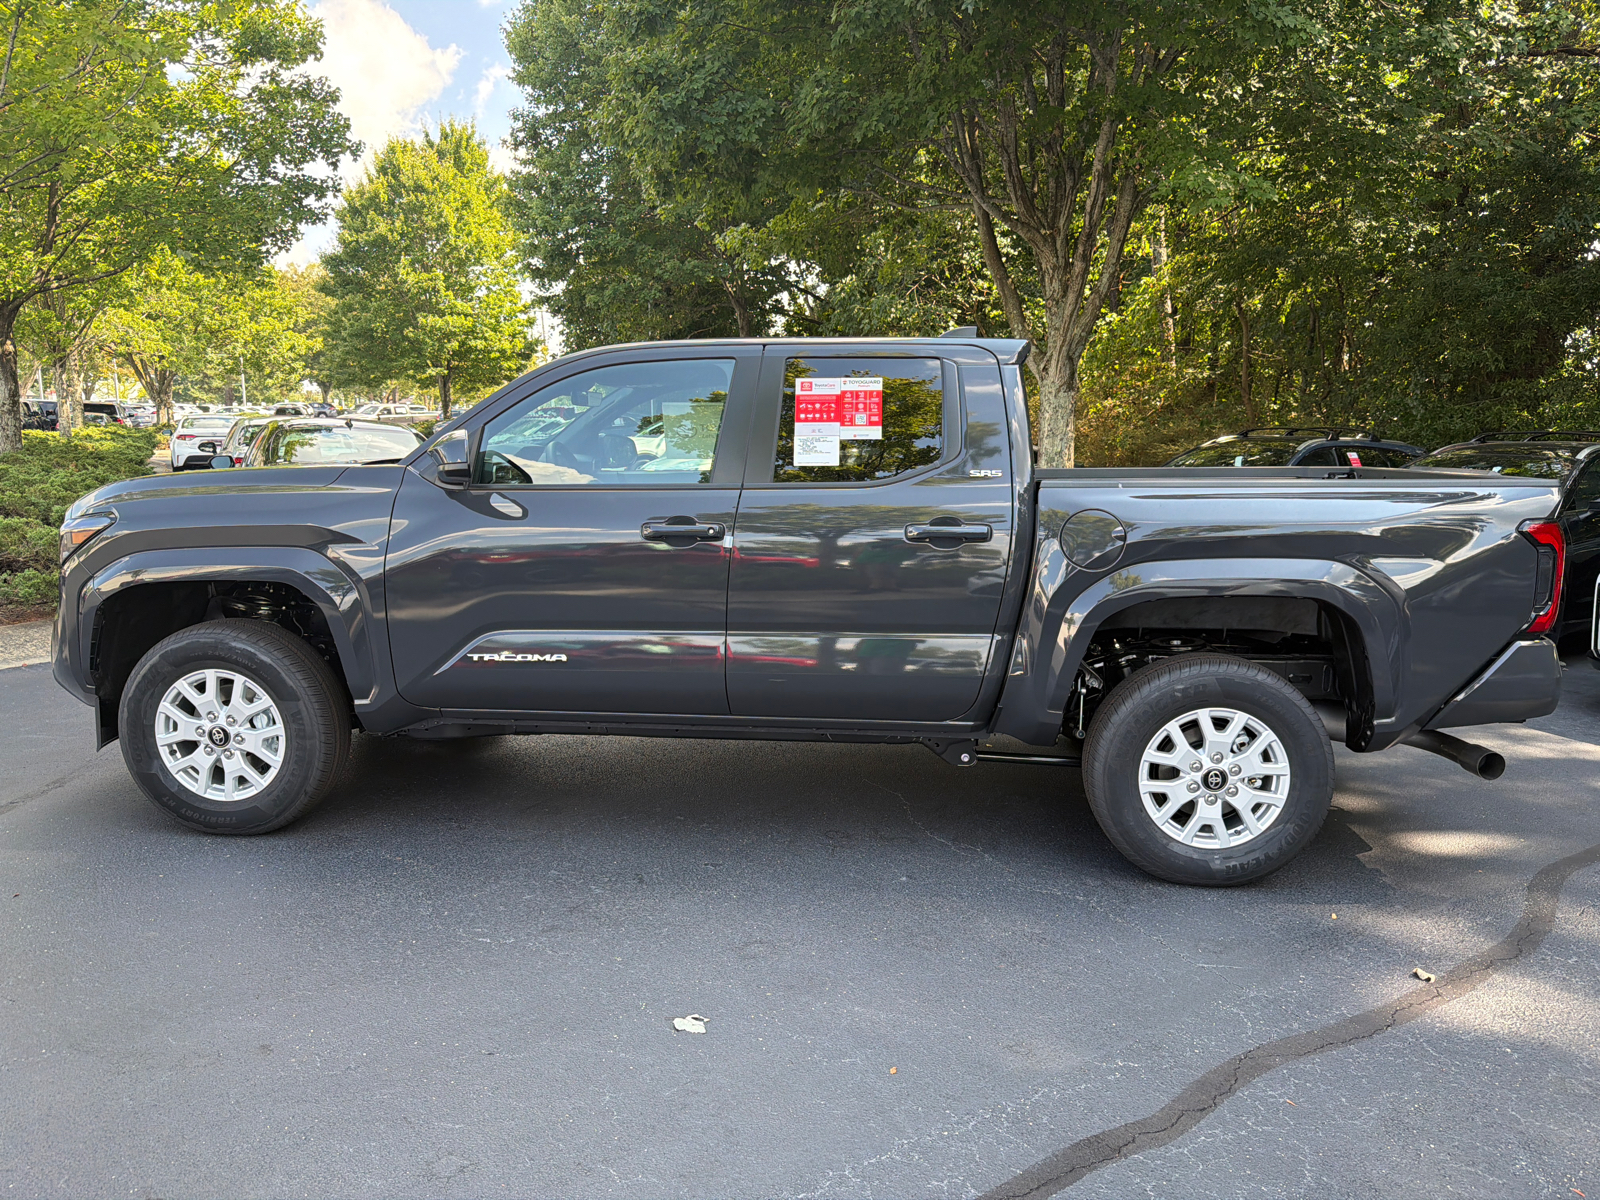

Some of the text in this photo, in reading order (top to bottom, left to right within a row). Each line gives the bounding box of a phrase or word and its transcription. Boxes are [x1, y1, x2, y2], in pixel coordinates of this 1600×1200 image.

[969, 469, 1003, 478] SR5
[466, 653, 568, 662] TACOMA
[178, 807, 238, 825] TERRITORY
